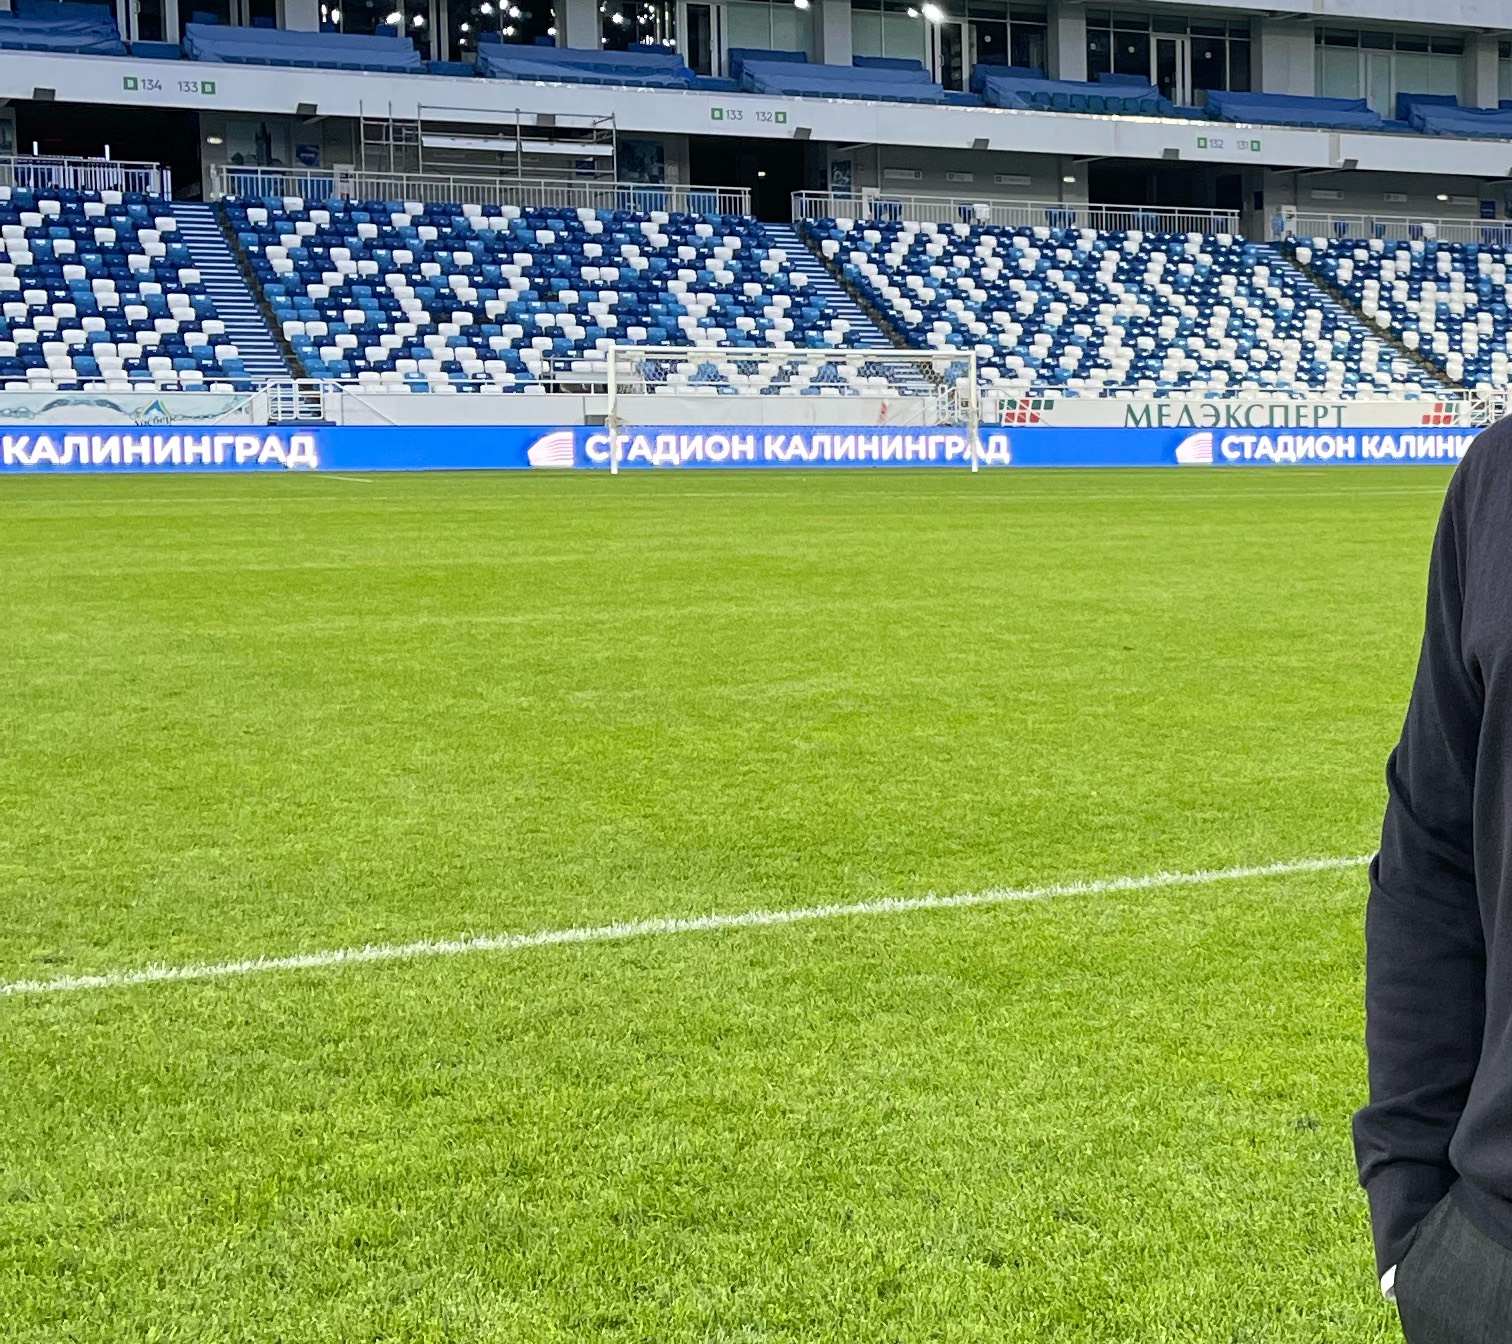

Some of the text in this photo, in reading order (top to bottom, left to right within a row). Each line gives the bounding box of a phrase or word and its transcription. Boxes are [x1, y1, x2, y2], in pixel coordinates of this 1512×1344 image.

[141, 78, 162, 91] 134
[177, 81, 199, 93] 133
[725, 109, 744, 121] 133
[755, 111, 773, 123] 132
[1209, 139, 1224, 149] 132
[2, 434, 320, 470] КАЛИНИНГРАД
[584, 434, 1011, 466] СТАДИОН КАЛИНИНГРАД
[1220, 433, 1355, 463] СТАДИОН
